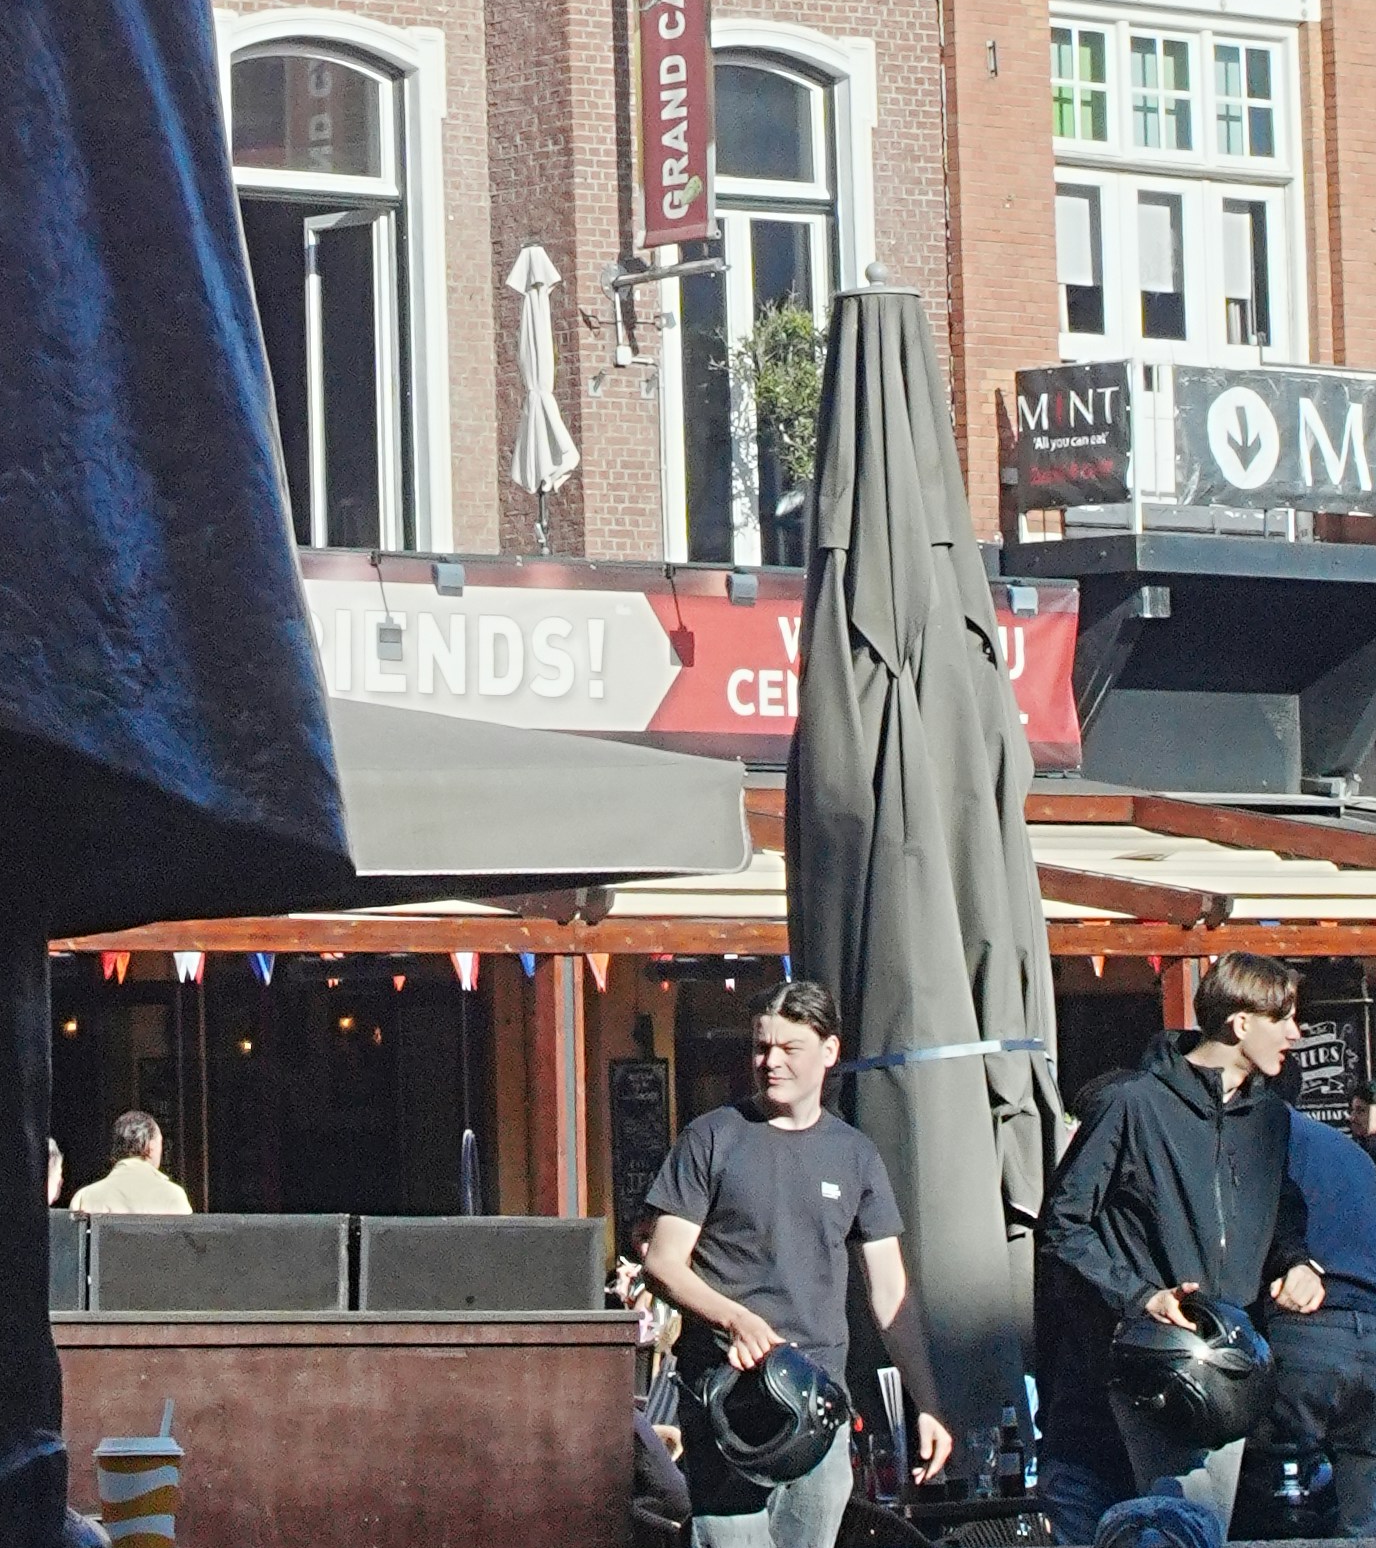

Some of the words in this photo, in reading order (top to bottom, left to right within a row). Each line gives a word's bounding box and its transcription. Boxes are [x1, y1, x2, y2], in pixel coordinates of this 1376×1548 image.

[660, 54, 690, 221] GRAND
[1017, 386, 1120, 433] MINT
[1070, 435, 1089, 448] can
[312, 608, 606, 700] IENDS!
